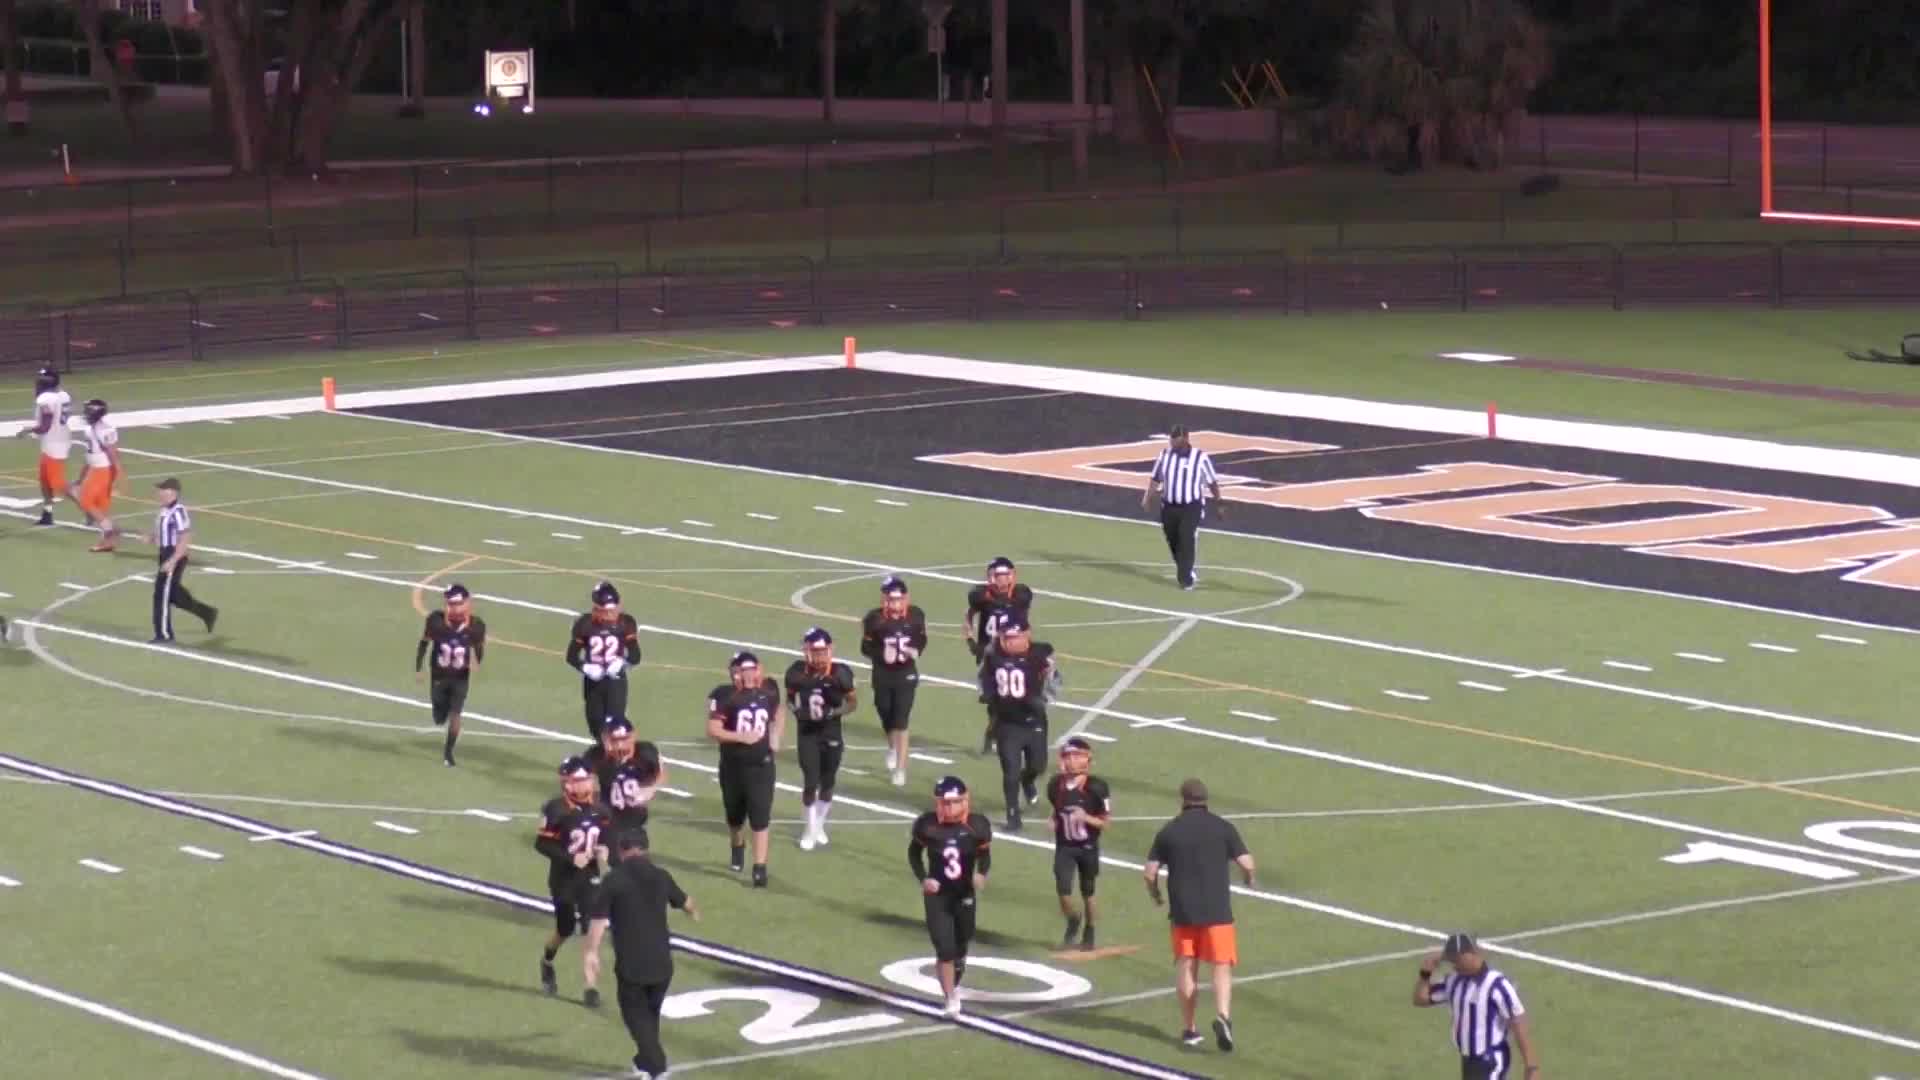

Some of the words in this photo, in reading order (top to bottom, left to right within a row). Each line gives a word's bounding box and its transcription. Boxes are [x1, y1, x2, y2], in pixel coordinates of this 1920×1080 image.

[590, 635, 619, 663] 22
[736, 708, 769, 741] 66
[610, 779, 642, 810] 49
[943, 846, 962, 880] 3
[1658, 819, 1920, 881] 10
[660, 956, 1091, 1044] 20
